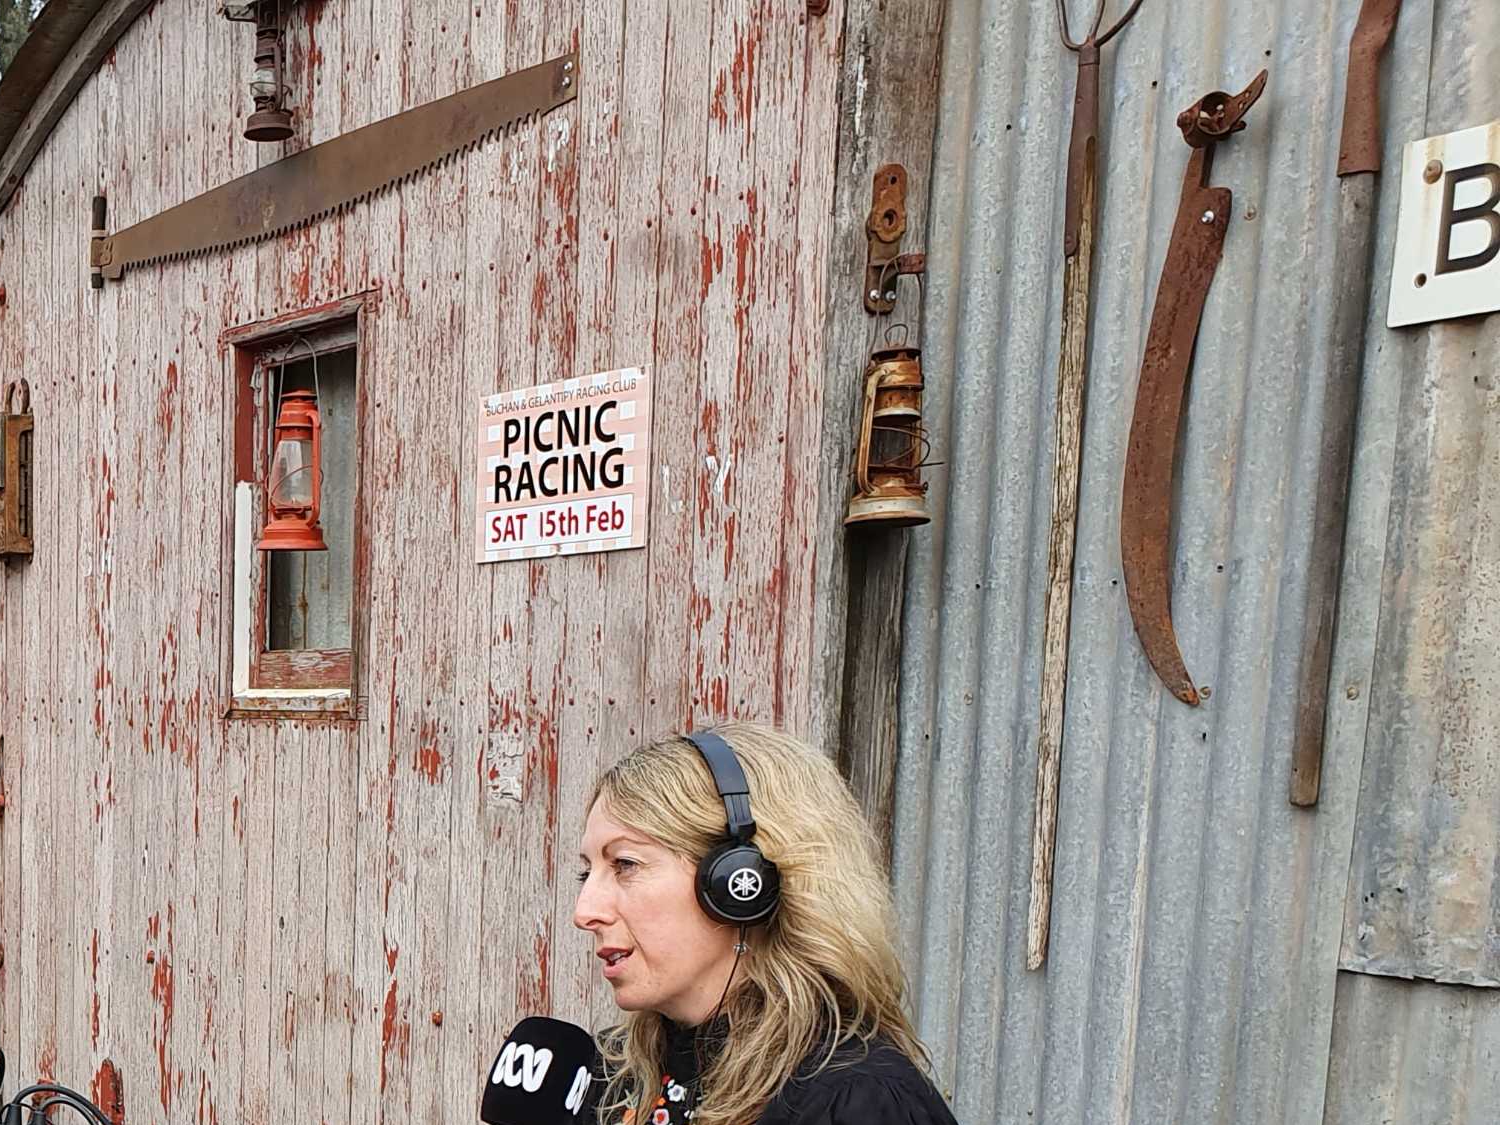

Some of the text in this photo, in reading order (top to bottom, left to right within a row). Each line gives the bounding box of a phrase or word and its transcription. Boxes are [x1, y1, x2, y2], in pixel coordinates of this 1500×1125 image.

[486, 378, 637, 417] BUCHAN & GELANTIPY RACING CLUB
[503, 400, 618, 458] PICNIC
[494, 447, 625, 504] RACING
[491, 501, 625, 543] SAT 15th Feb
